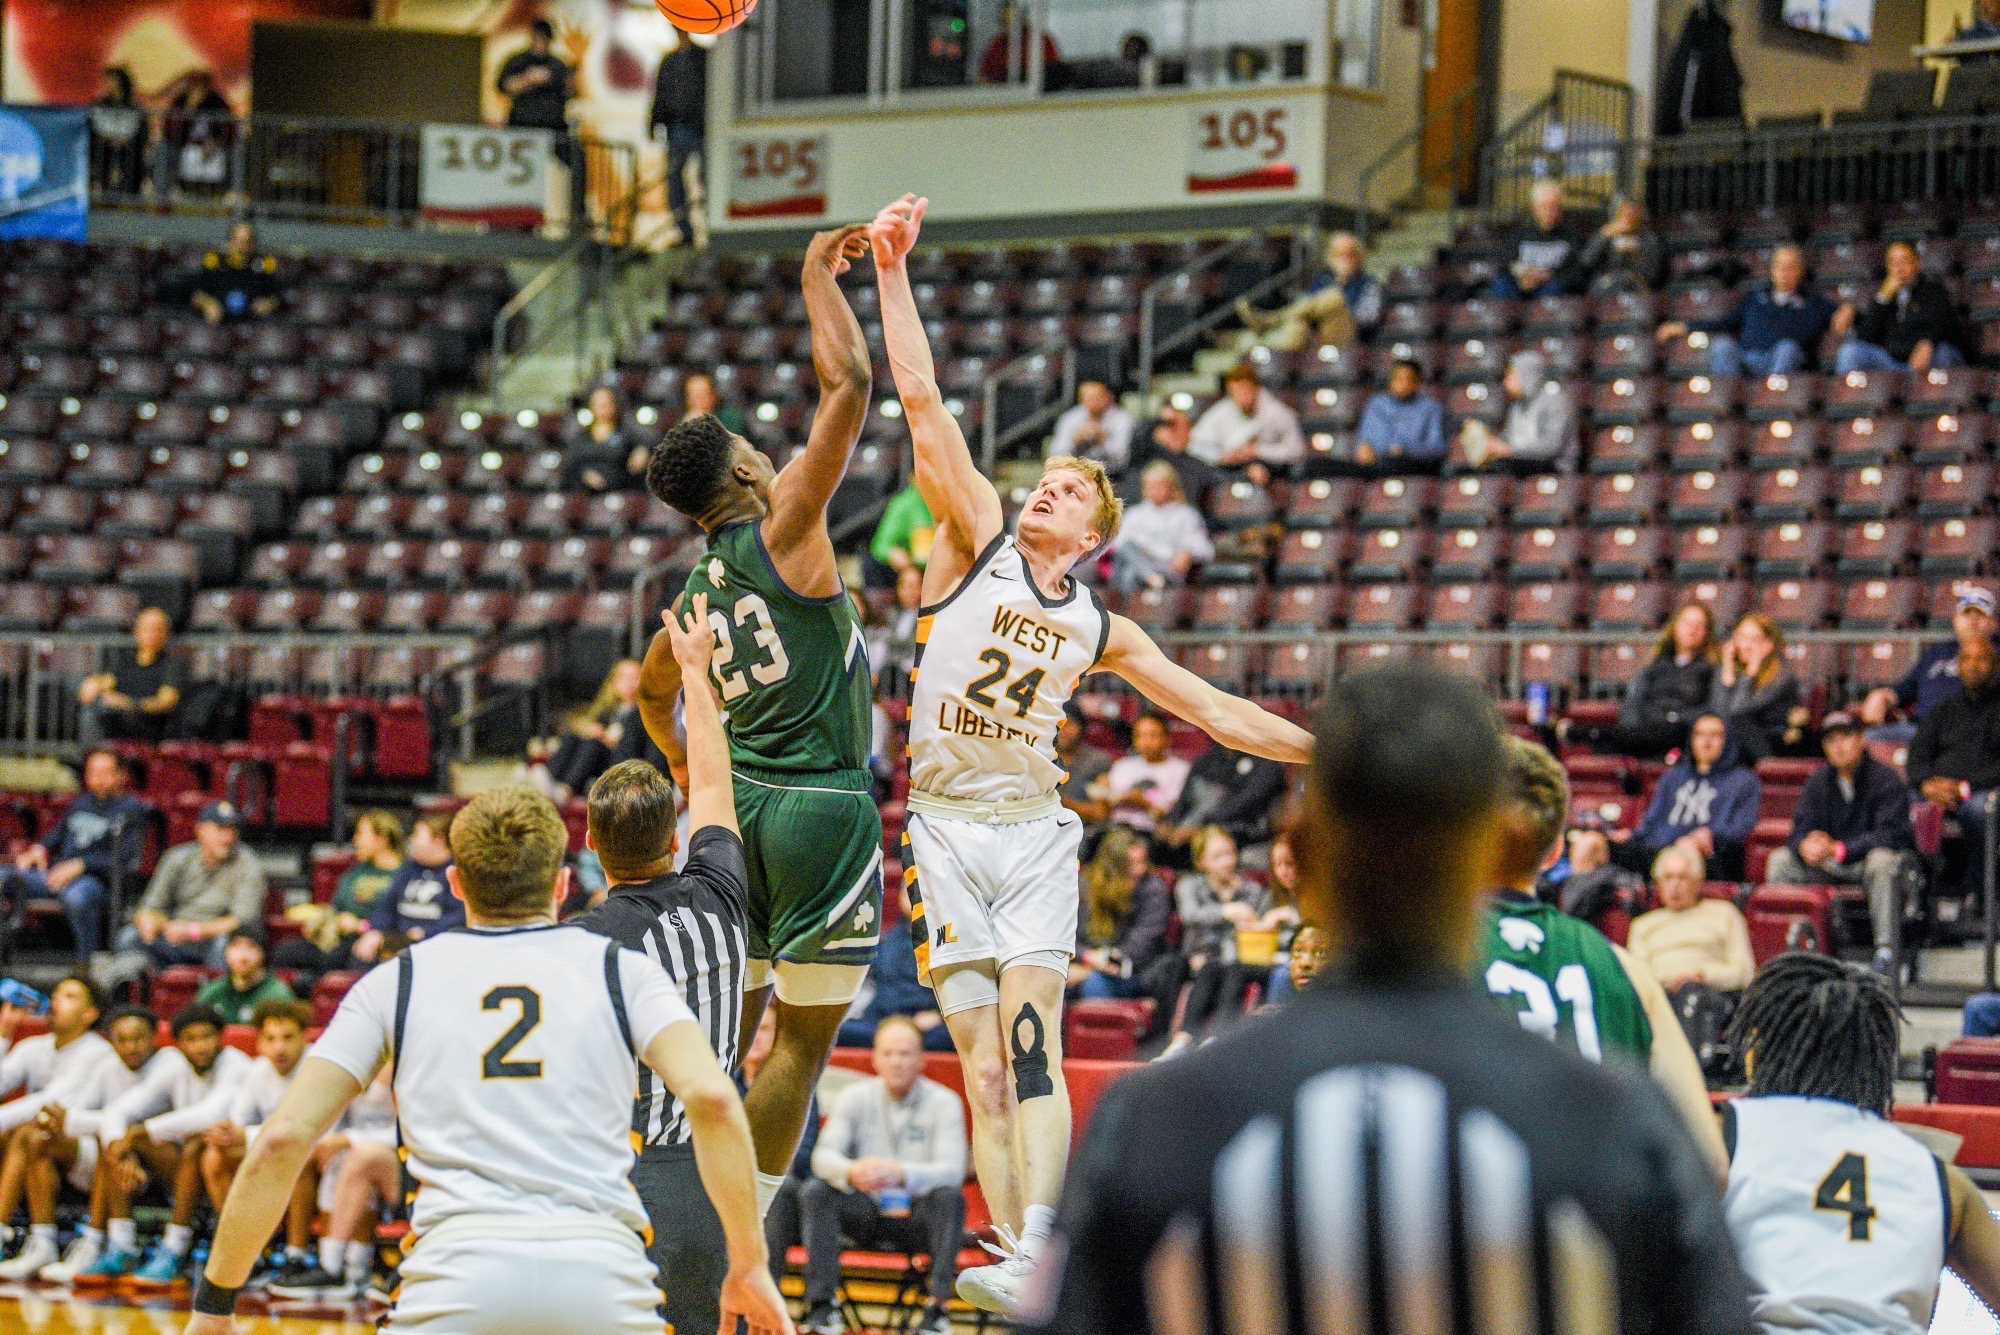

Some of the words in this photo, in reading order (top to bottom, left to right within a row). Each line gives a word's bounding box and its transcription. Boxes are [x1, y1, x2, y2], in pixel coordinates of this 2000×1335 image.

[440, 134, 535, 186] 105
[740, 139, 818, 189] 105
[1200, 108, 1288, 159] 105
[708, 593, 790, 702] 23
[991, 604, 1067, 661] WEST
[964, 646, 1048, 720] 24
[480, 983, 544, 1081] 2
[1813, 1149, 1878, 1243] 4
